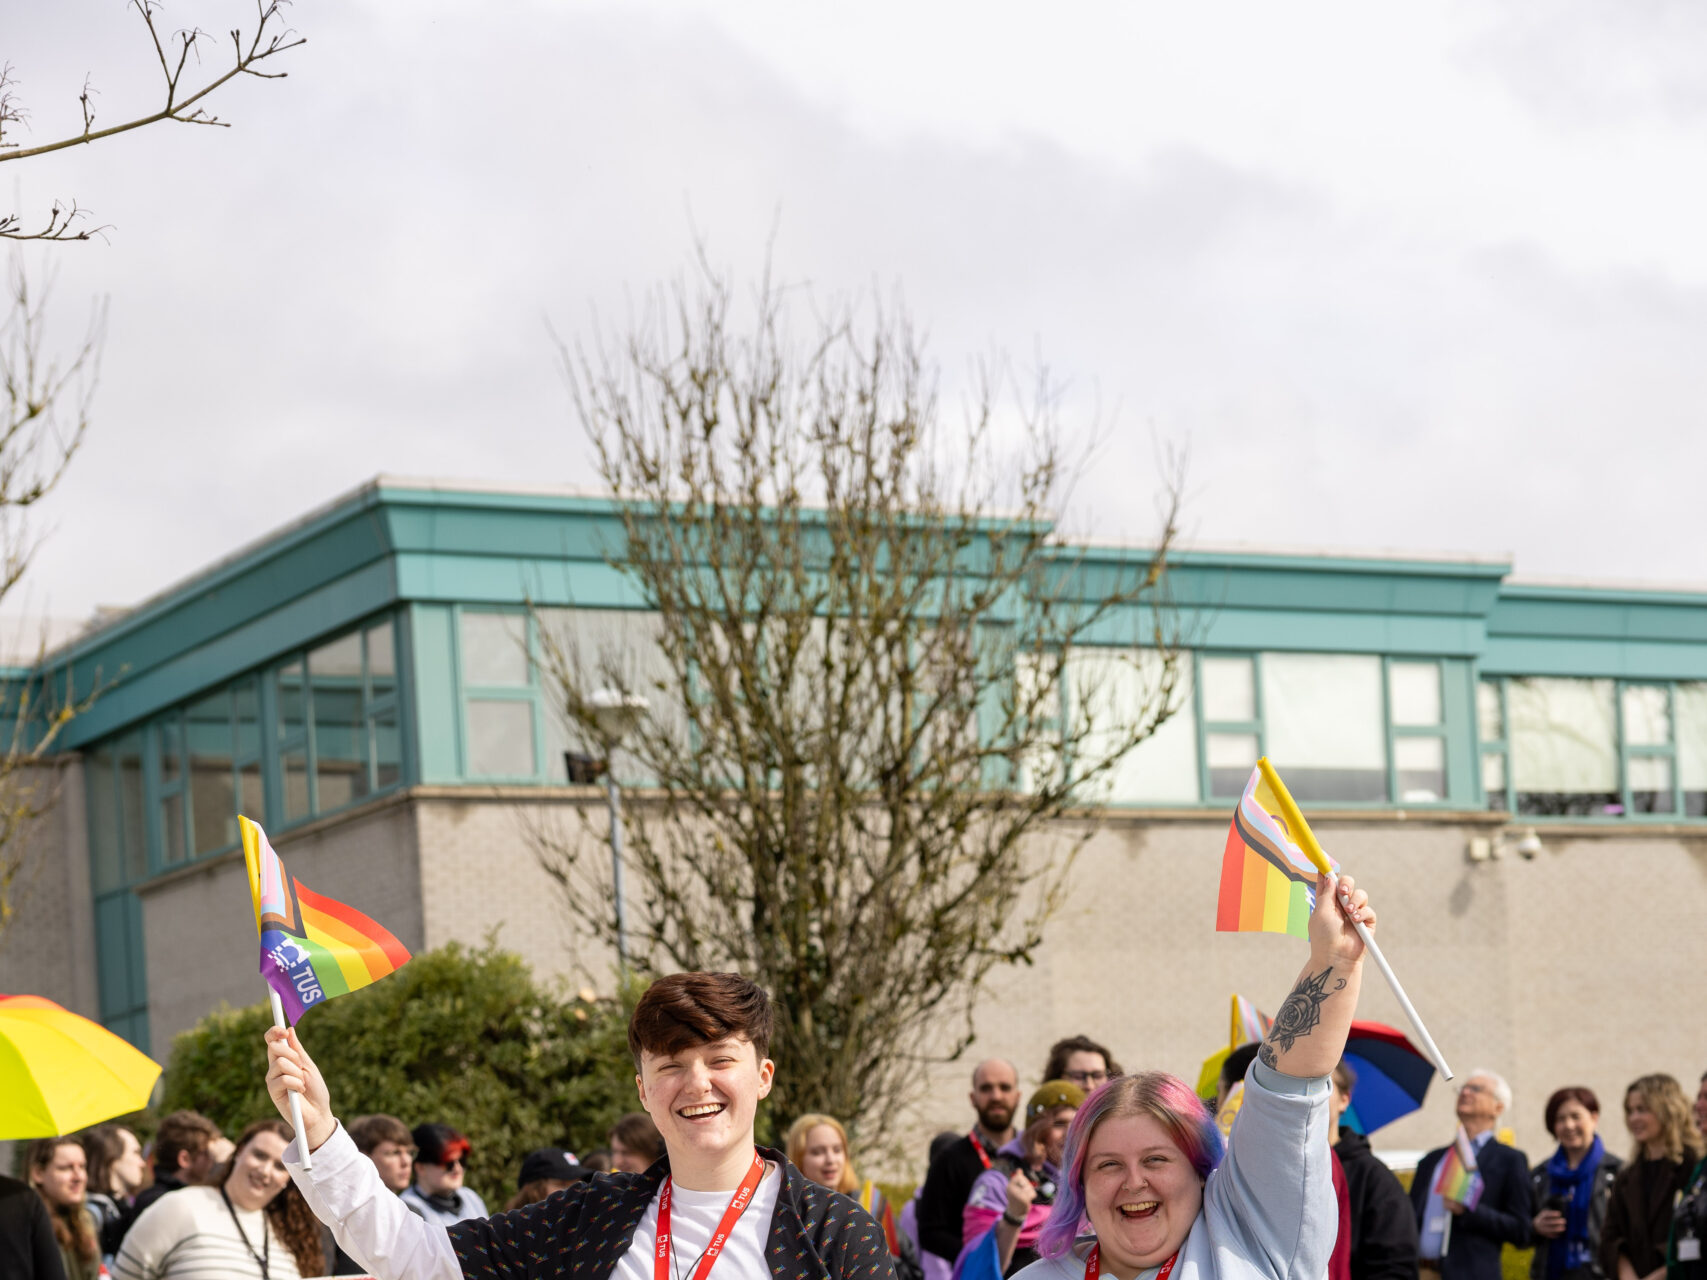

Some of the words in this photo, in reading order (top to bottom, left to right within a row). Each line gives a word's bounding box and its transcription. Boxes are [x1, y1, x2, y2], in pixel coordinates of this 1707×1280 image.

[293, 966, 322, 1004] TUS
[738, 1187, 750, 1201] TUS
[661, 1197, 669, 1210] TUS
[713, 1233, 725, 1247] TUS
